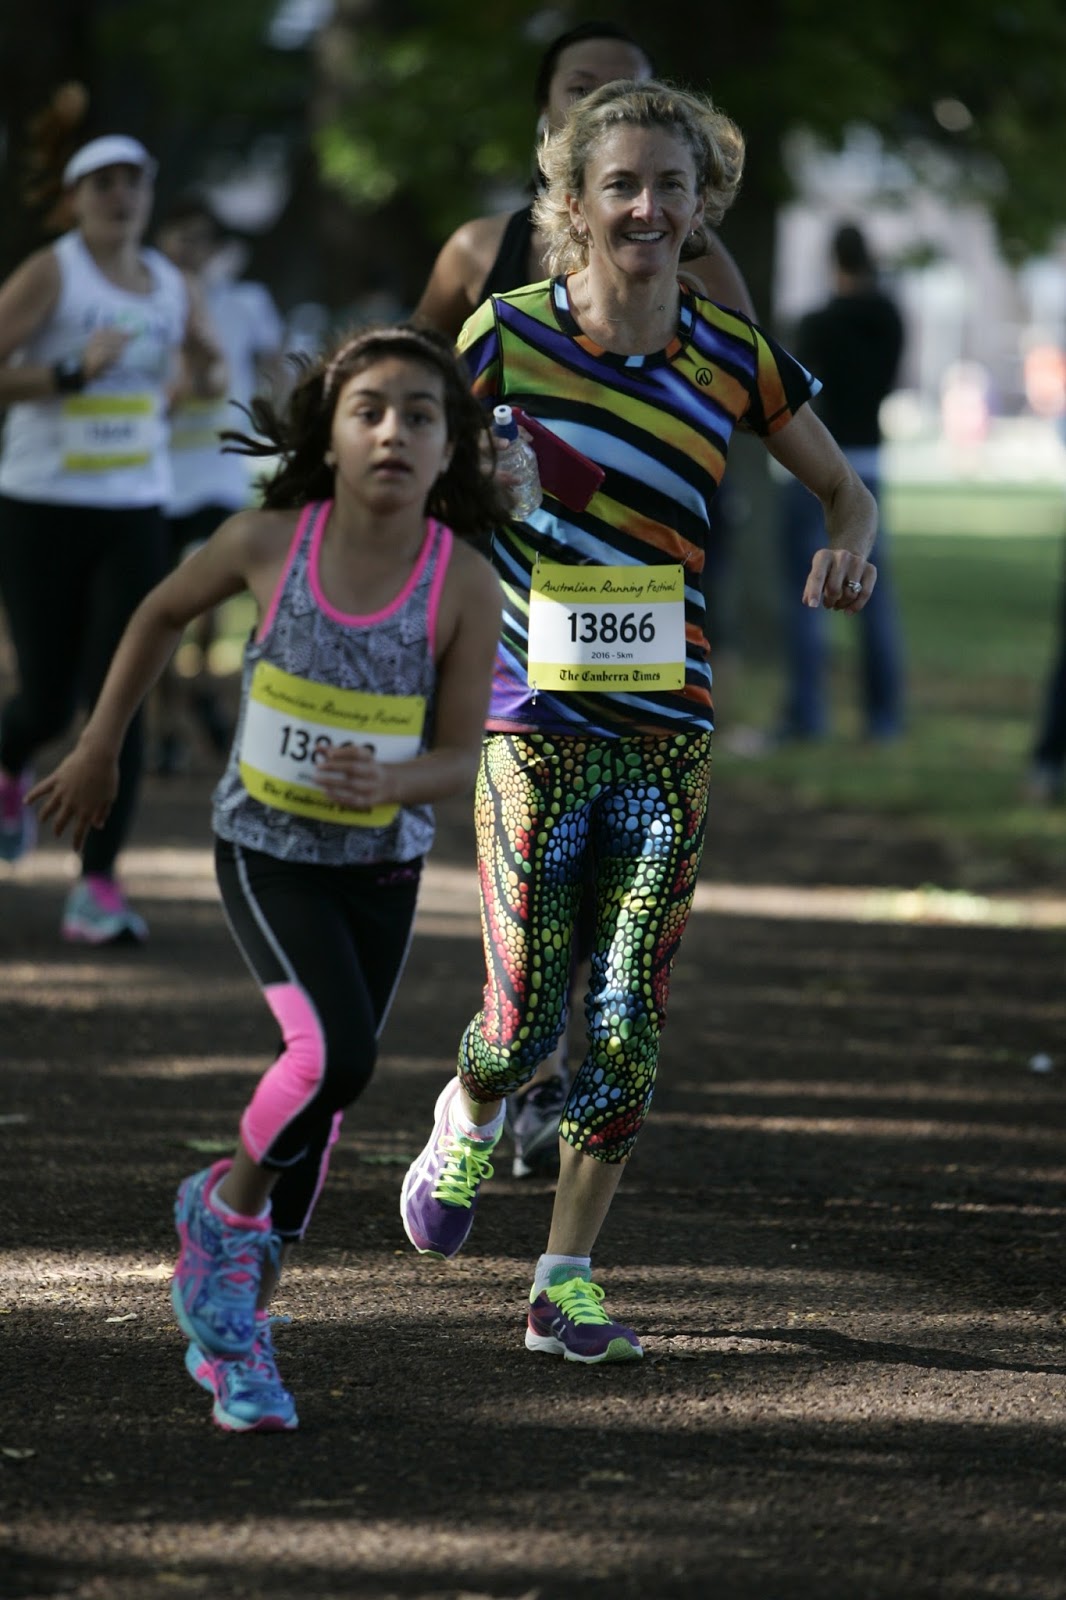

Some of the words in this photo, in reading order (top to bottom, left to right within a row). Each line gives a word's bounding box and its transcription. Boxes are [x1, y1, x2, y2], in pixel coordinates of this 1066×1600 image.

[540, 580, 597, 593] Australian
[600, 579, 644, 598] Running
[647, 579, 677, 593] Festival
[567, 612, 656, 644] 13866
[591, 651, 610, 660] 2016
[616, 651, 634, 660] 5km
[559, 669, 580, 682] The
[582, 670, 629, 682] Canberra
[632, 669, 661, 682] Times
[280, 724, 376, 766] 138
